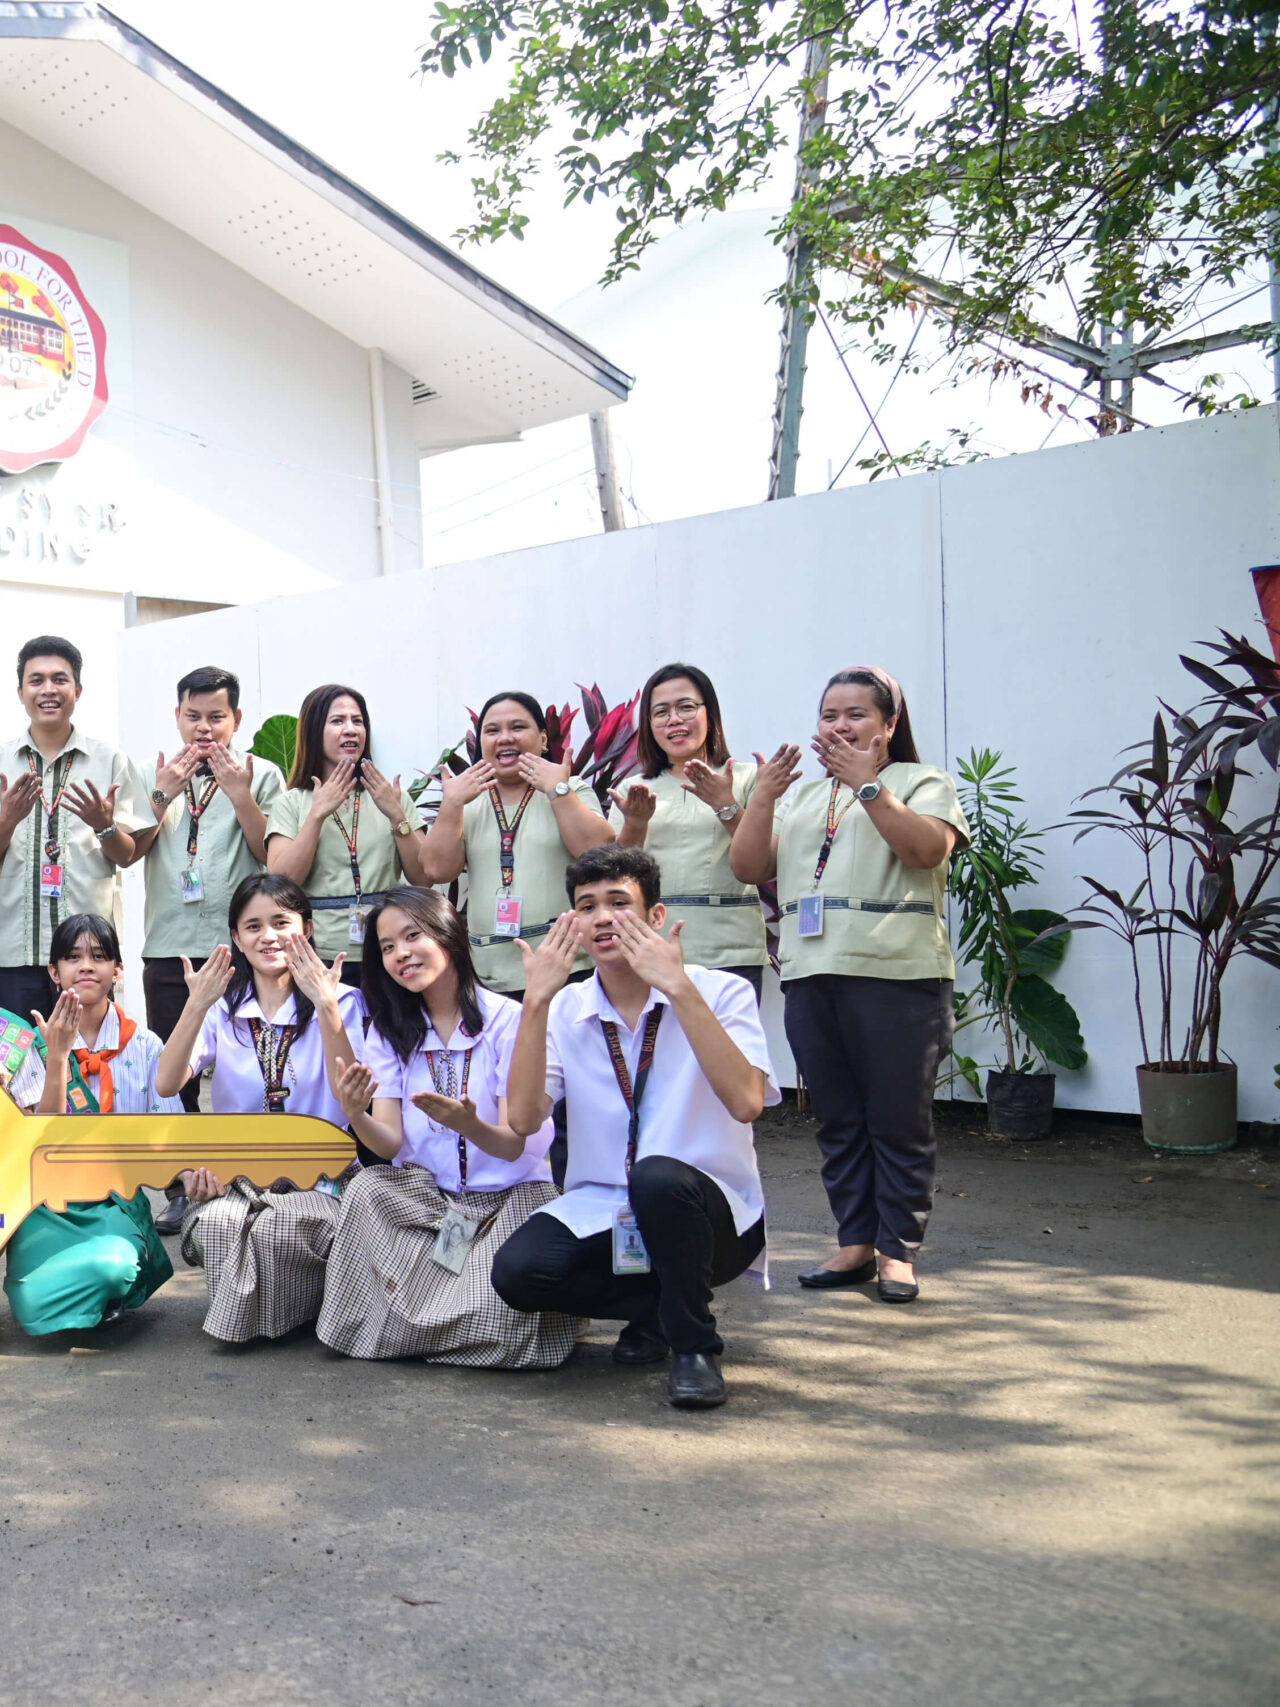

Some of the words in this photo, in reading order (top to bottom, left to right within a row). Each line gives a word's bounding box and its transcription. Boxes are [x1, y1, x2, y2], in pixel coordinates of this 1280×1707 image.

[36, 267, 72, 311] FOR
[70, 313, 92, 365] THE
[17, 486, 53, 522] SY
[642, 1022, 658, 1052] BULSU
[608, 1035, 622, 1056] STATE
[615, 1057, 634, 1099] UNIVERSITY
